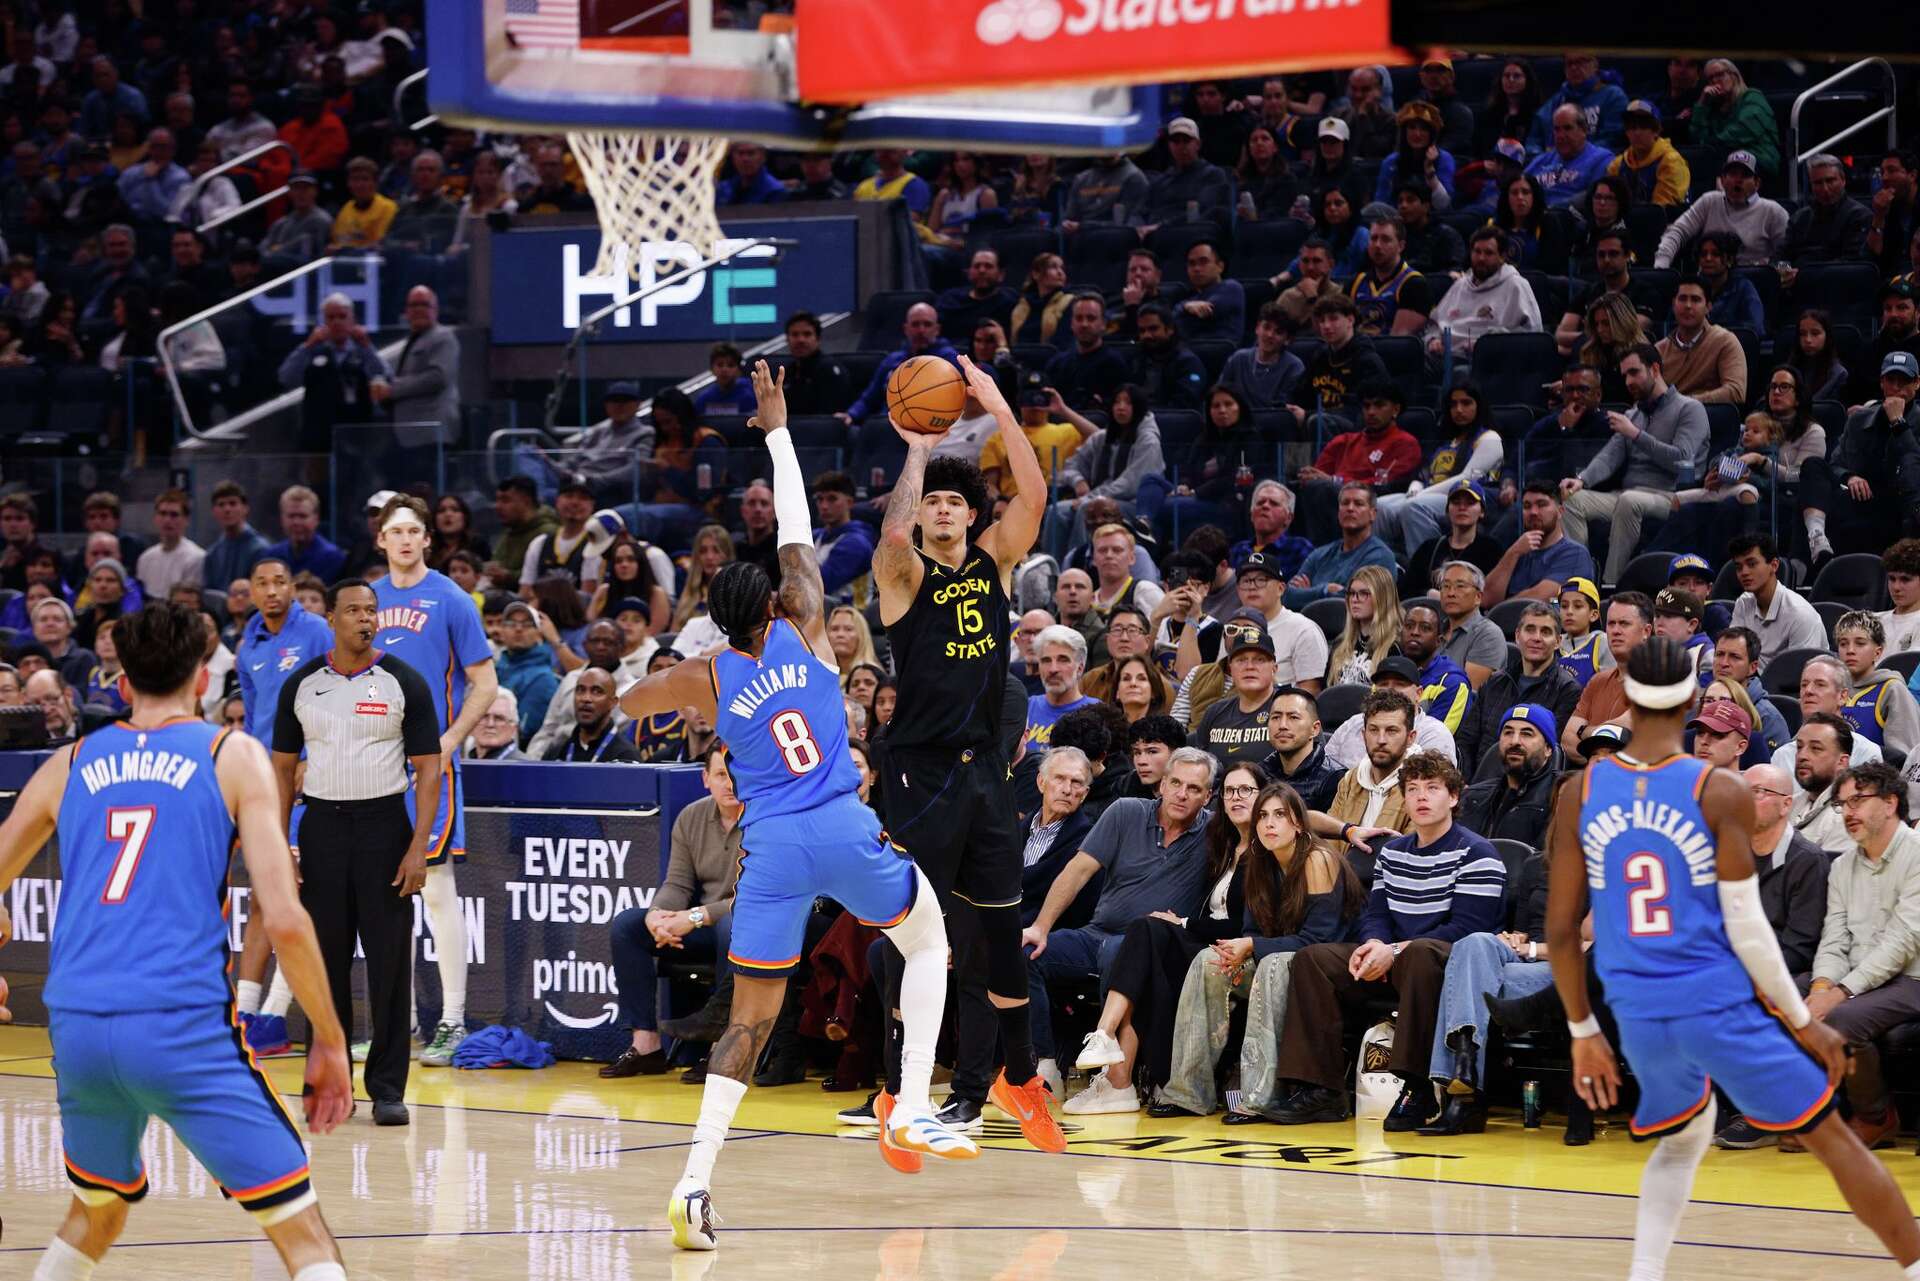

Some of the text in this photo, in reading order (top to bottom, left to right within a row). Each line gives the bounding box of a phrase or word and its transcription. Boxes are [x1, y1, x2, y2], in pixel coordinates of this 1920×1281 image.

[563, 238, 777, 328] HPE
[376, 607, 428, 633] HUNDER
[956, 598, 984, 636] 15
[945, 633, 996, 659] STATE
[728, 663, 808, 720] WILLIAMS
[769, 708, 823, 776] 8
[1209, 727, 1270, 743] GOLDEN STAT
[81, 750, 198, 796] HOLMGREN
[100, 804, 157, 904] 7
[525, 836, 632, 879] EVERY
[1624, 850, 1674, 937] 2
